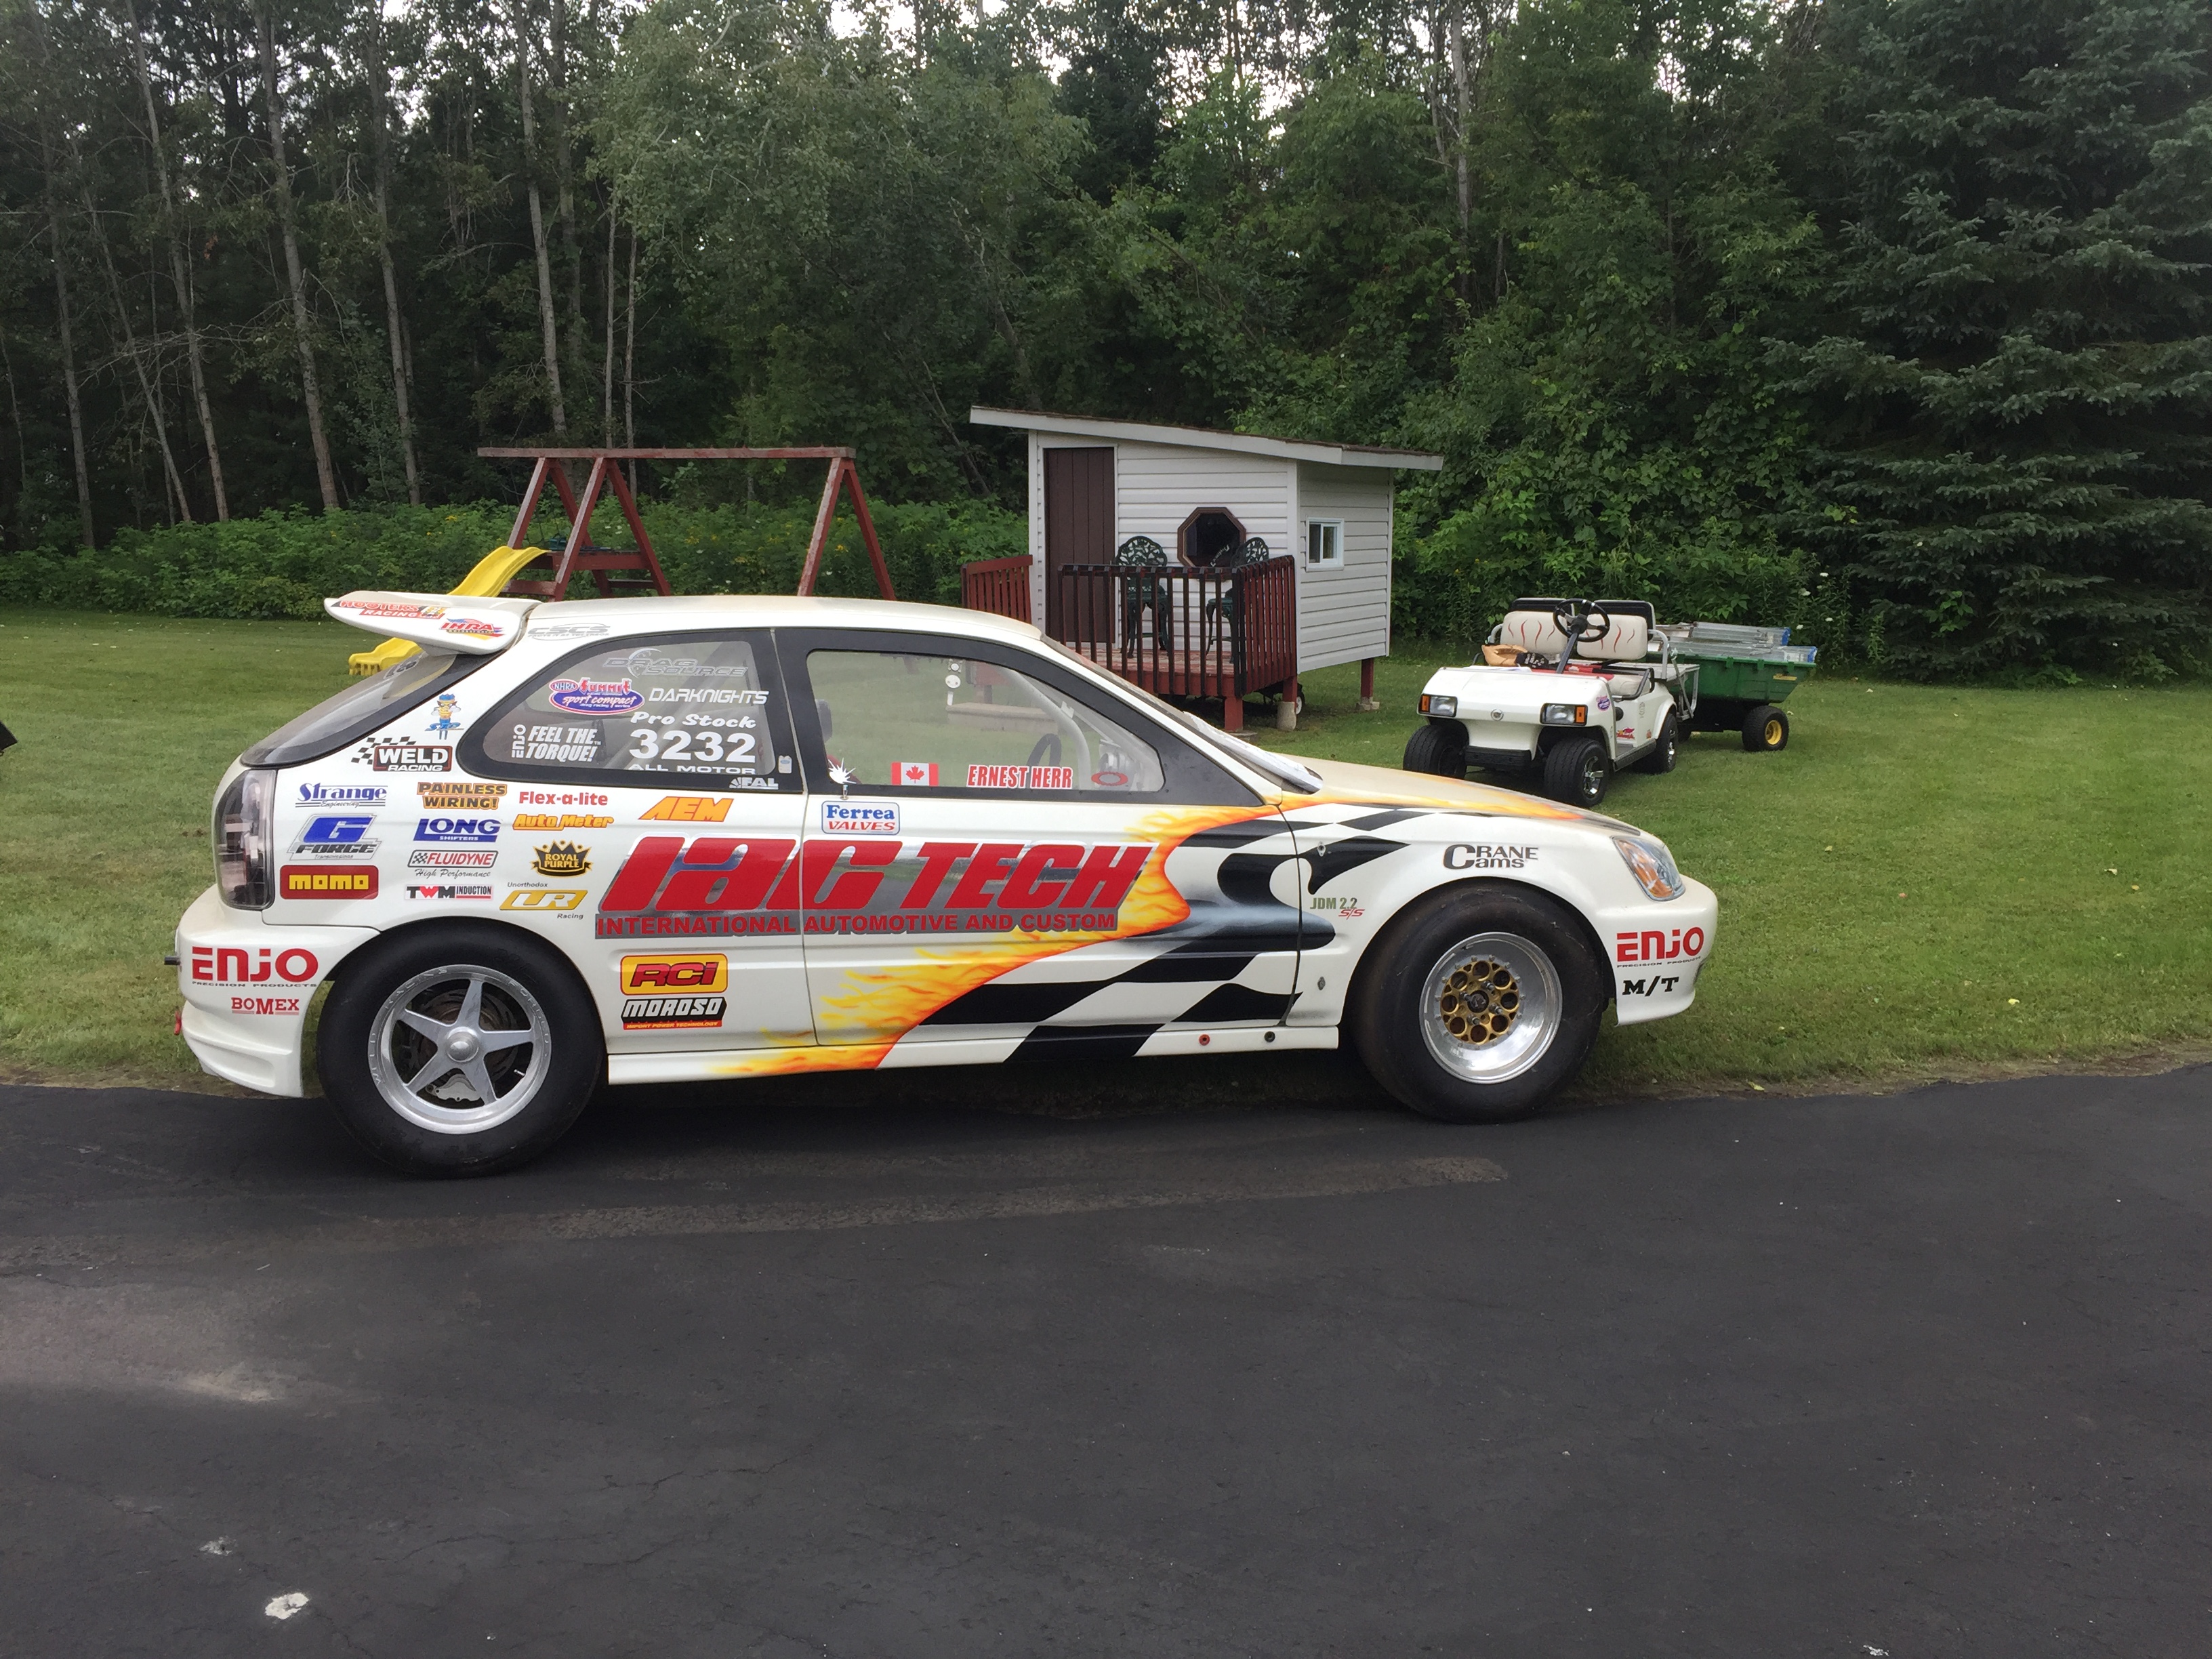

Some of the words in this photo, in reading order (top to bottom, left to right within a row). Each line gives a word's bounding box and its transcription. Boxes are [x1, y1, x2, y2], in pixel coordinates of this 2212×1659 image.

[340, 601, 419, 612] HOOTERS
[441, 622, 493, 631] IHRA
[528, 626, 611, 634] CSCS
[603, 657, 697, 668] DRAG
[642, 666, 748, 677] SOURCE
[562, 695, 592, 707] sport
[591, 696, 637, 708] compact
[649, 688, 769, 705] DARKNIGHTS
[630, 712, 675, 725] Pro
[682, 714, 756, 728] Stock
[528, 726, 563, 743] FEEL
[566, 727, 598, 745] THE
[525, 743, 598, 762] TORQUE!
[629, 729, 756, 763] 3232
[378, 748, 449, 764] WELD
[677, 766, 756, 775] MOTOR
[967, 765, 1029, 787] ERNEST
[1031, 766, 1073, 788] HERR
[417, 782, 508, 796] PAINLESS
[741, 777, 779, 787] FAL
[297, 782, 388, 802] Strange
[519, 791, 609, 806] Flex-a-lite
[321, 800, 360, 808] Engineering
[423, 796, 499, 810] WIRING!
[638, 796, 734, 822] AEM
[826, 804, 895, 820] Ferrea
[514, 814, 558, 829] Auto
[558, 814, 615, 828] Meter
[828, 821, 895, 831] VALVES
[413, 818, 501, 841] LONG
[295, 844, 377, 854] FORCE
[426, 853, 494, 865] FLUIDYNE
[545, 853, 579, 861] ROYAL
[1443, 844, 1538, 869] CRANE
[415, 868, 437, 879] High
[441, 868, 491, 879] Performance
[899, 842, 1153, 909] TECH
[407, 886, 455, 899] TWM
[456, 886, 491, 895] INDUCTION
[1310, 897, 1336, 909] JDM
[1339, 897, 1357, 909] 2.2
[596, 915, 797, 936] INTERNATIONAL
[803, 914, 958, 933] AUTOMOTIVE
[966, 914, 1013, 930] AND
[1020, 914, 1116, 930] CUSTOM
[1667, 956, 1701, 965] PRODUCTS
[1622, 975, 1680, 997] M/T
[231, 998, 300, 1015] BOMEX
[622, 998, 723, 1017] MOROSO
